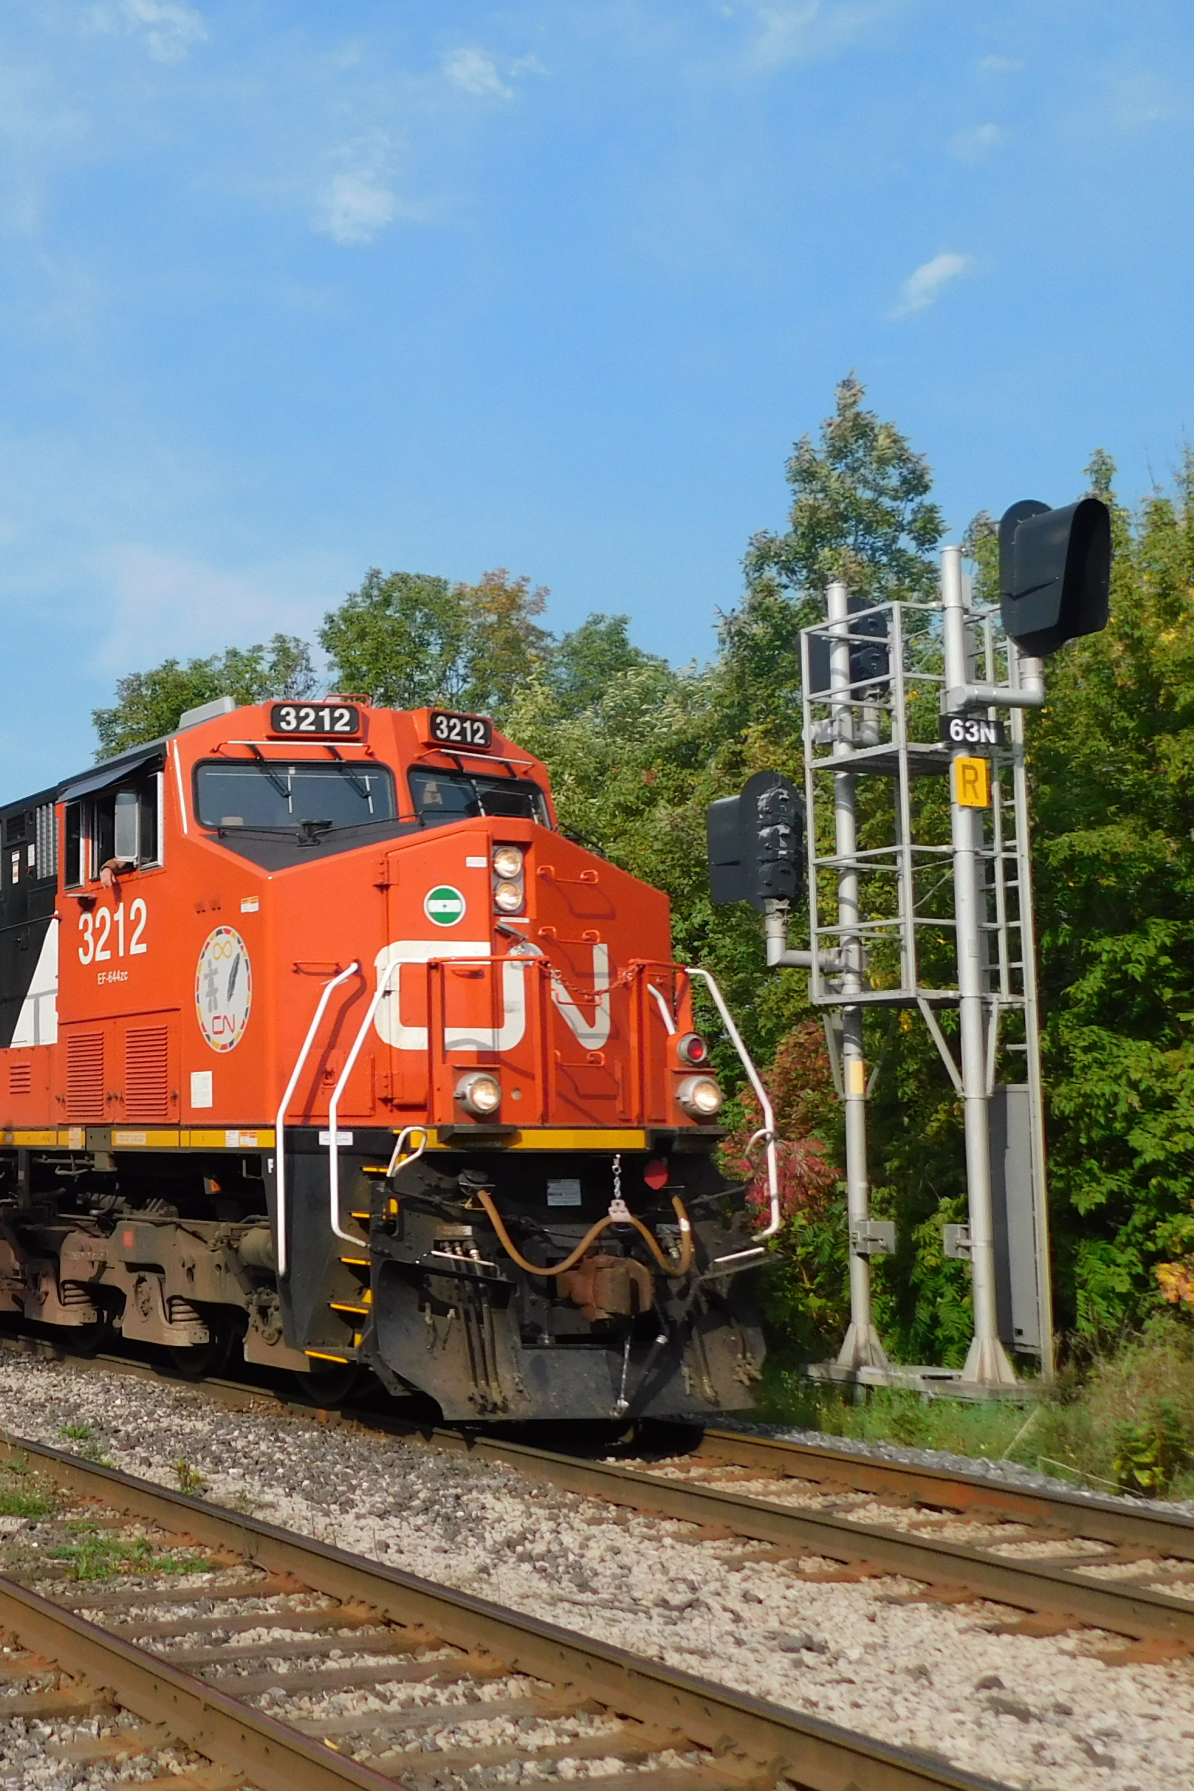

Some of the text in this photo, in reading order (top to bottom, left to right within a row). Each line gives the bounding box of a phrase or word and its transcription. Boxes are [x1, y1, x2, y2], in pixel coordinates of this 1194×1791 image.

[280, 707, 351, 731] 3212
[435, 715, 485, 745] 3212
[950, 719, 997, 744] 63N
[961, 764, 980, 800] R
[78, 898, 148, 965] 3212
[374, 940, 611, 1050] CN
[212, 1014, 236, 1035] CN
